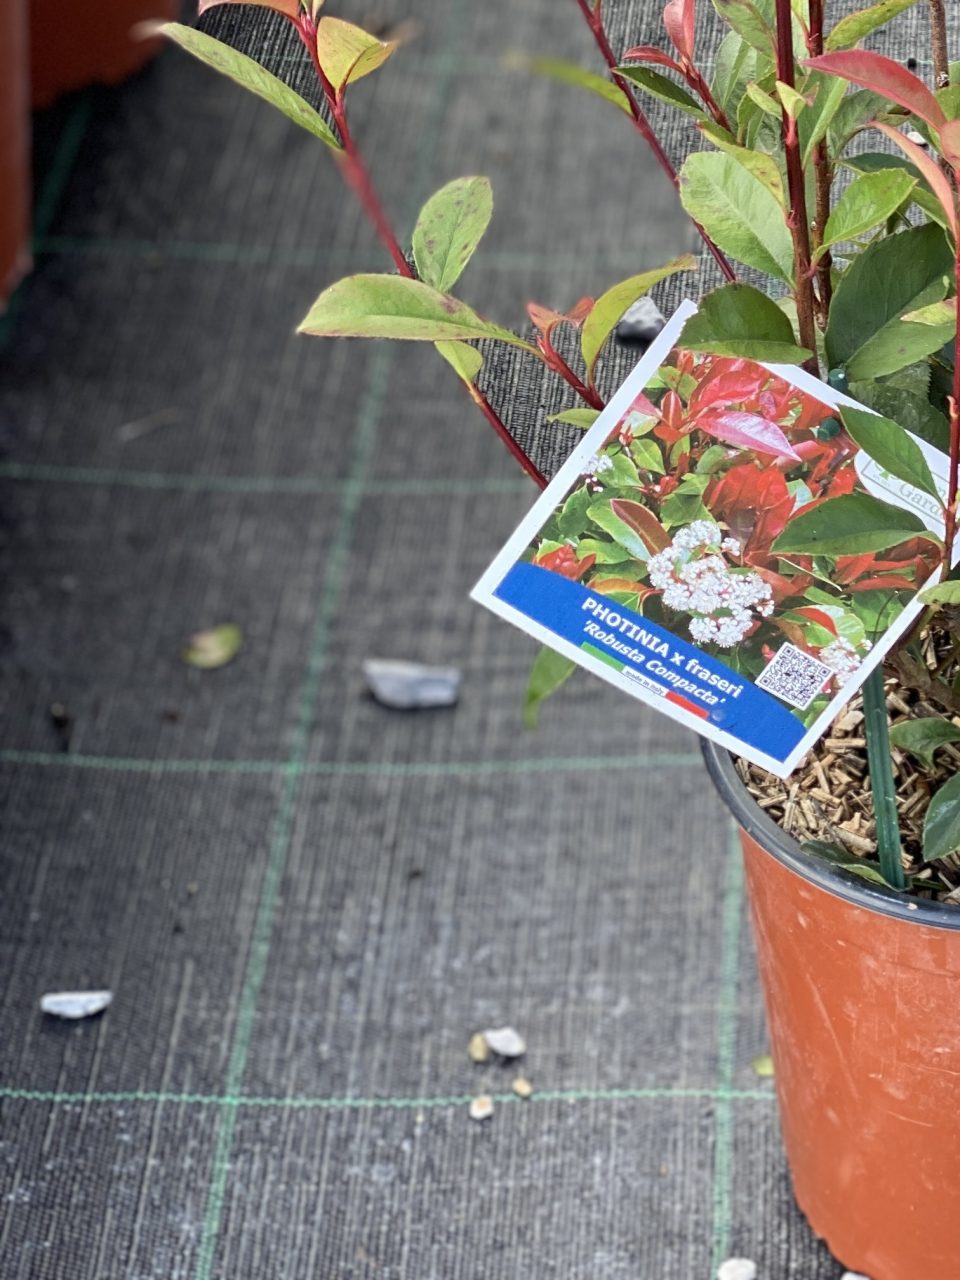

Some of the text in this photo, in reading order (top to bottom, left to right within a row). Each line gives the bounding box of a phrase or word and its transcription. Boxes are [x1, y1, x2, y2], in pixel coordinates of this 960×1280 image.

[581, 597, 744, 698] PHOTINIA x fraseri
[583, 620, 726, 705] 'Robusta Compacta'
